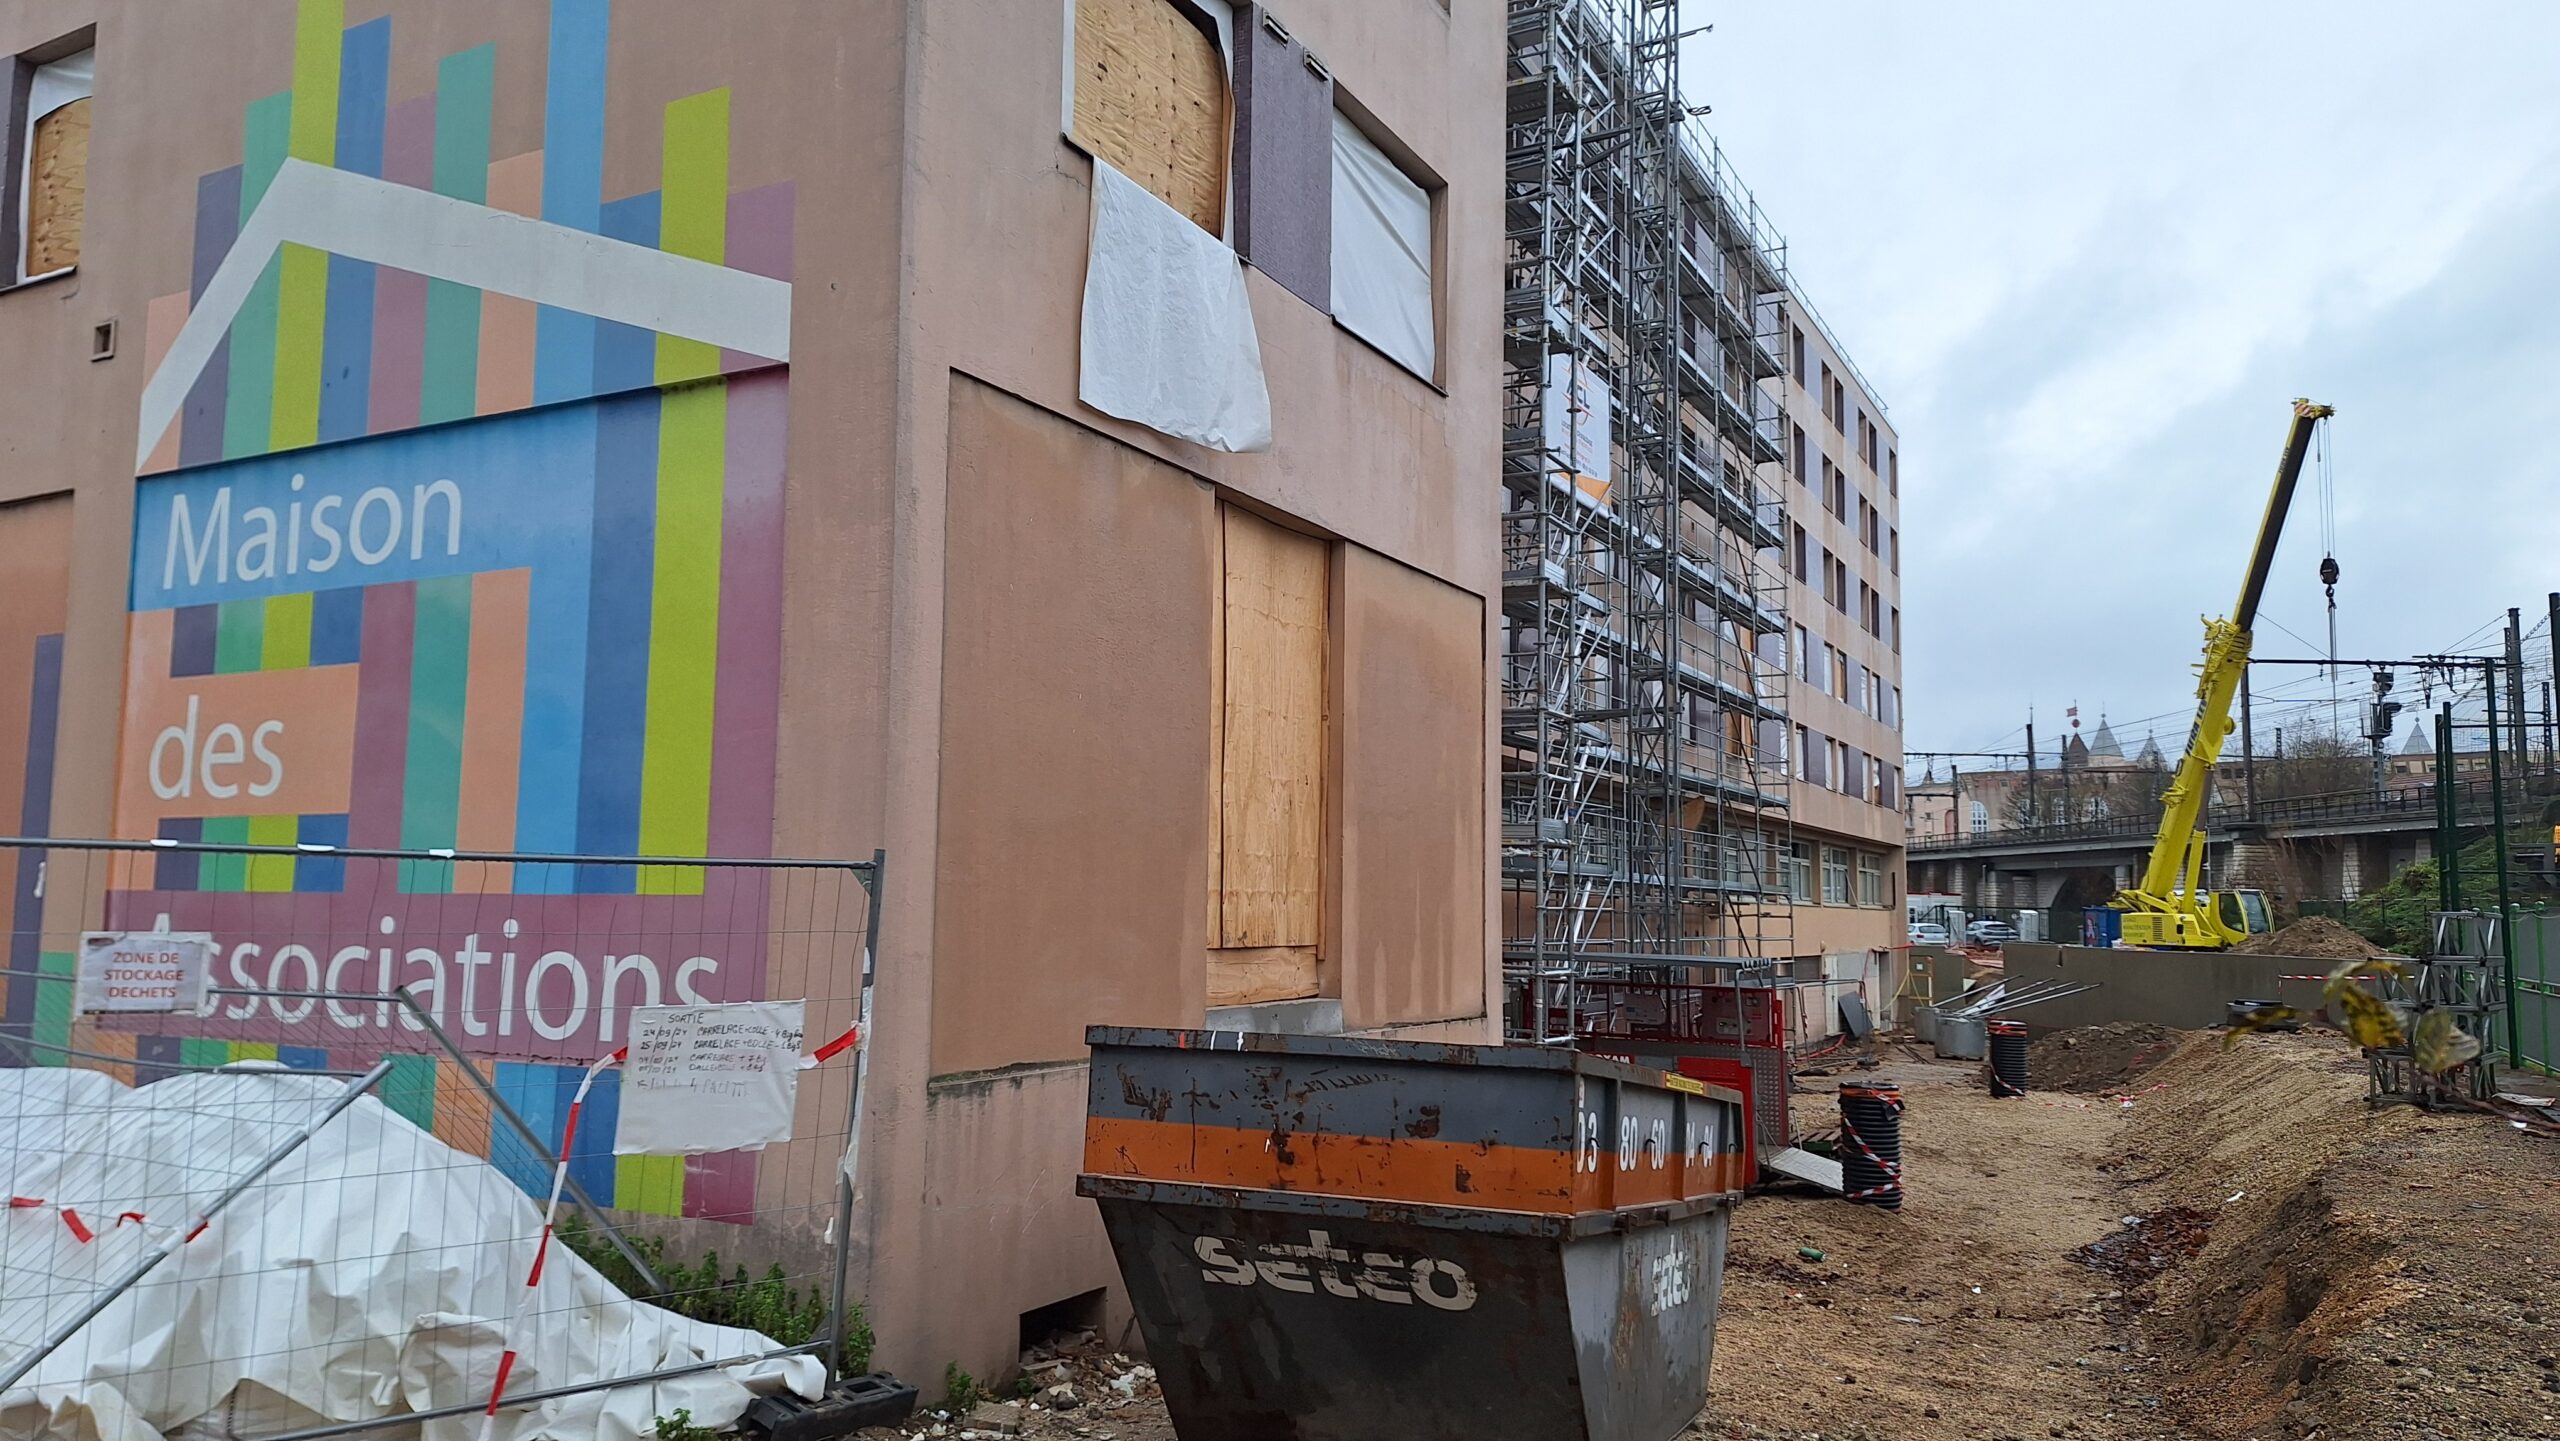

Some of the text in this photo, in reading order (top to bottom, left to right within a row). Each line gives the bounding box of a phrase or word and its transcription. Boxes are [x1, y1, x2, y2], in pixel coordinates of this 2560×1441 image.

[162, 473, 462, 590] Maison
[147, 694, 285, 800] des
[112, 952, 179, 964] ZONE DE
[104, 969, 185, 981] STOCKAGE
[108, 987, 177, 998] DECHETS
[668, 1013, 704, 1024] SORTIE
[1619, 1115, 1639, 1172] 80
[1650, 1118, 1666, 1171] 60
